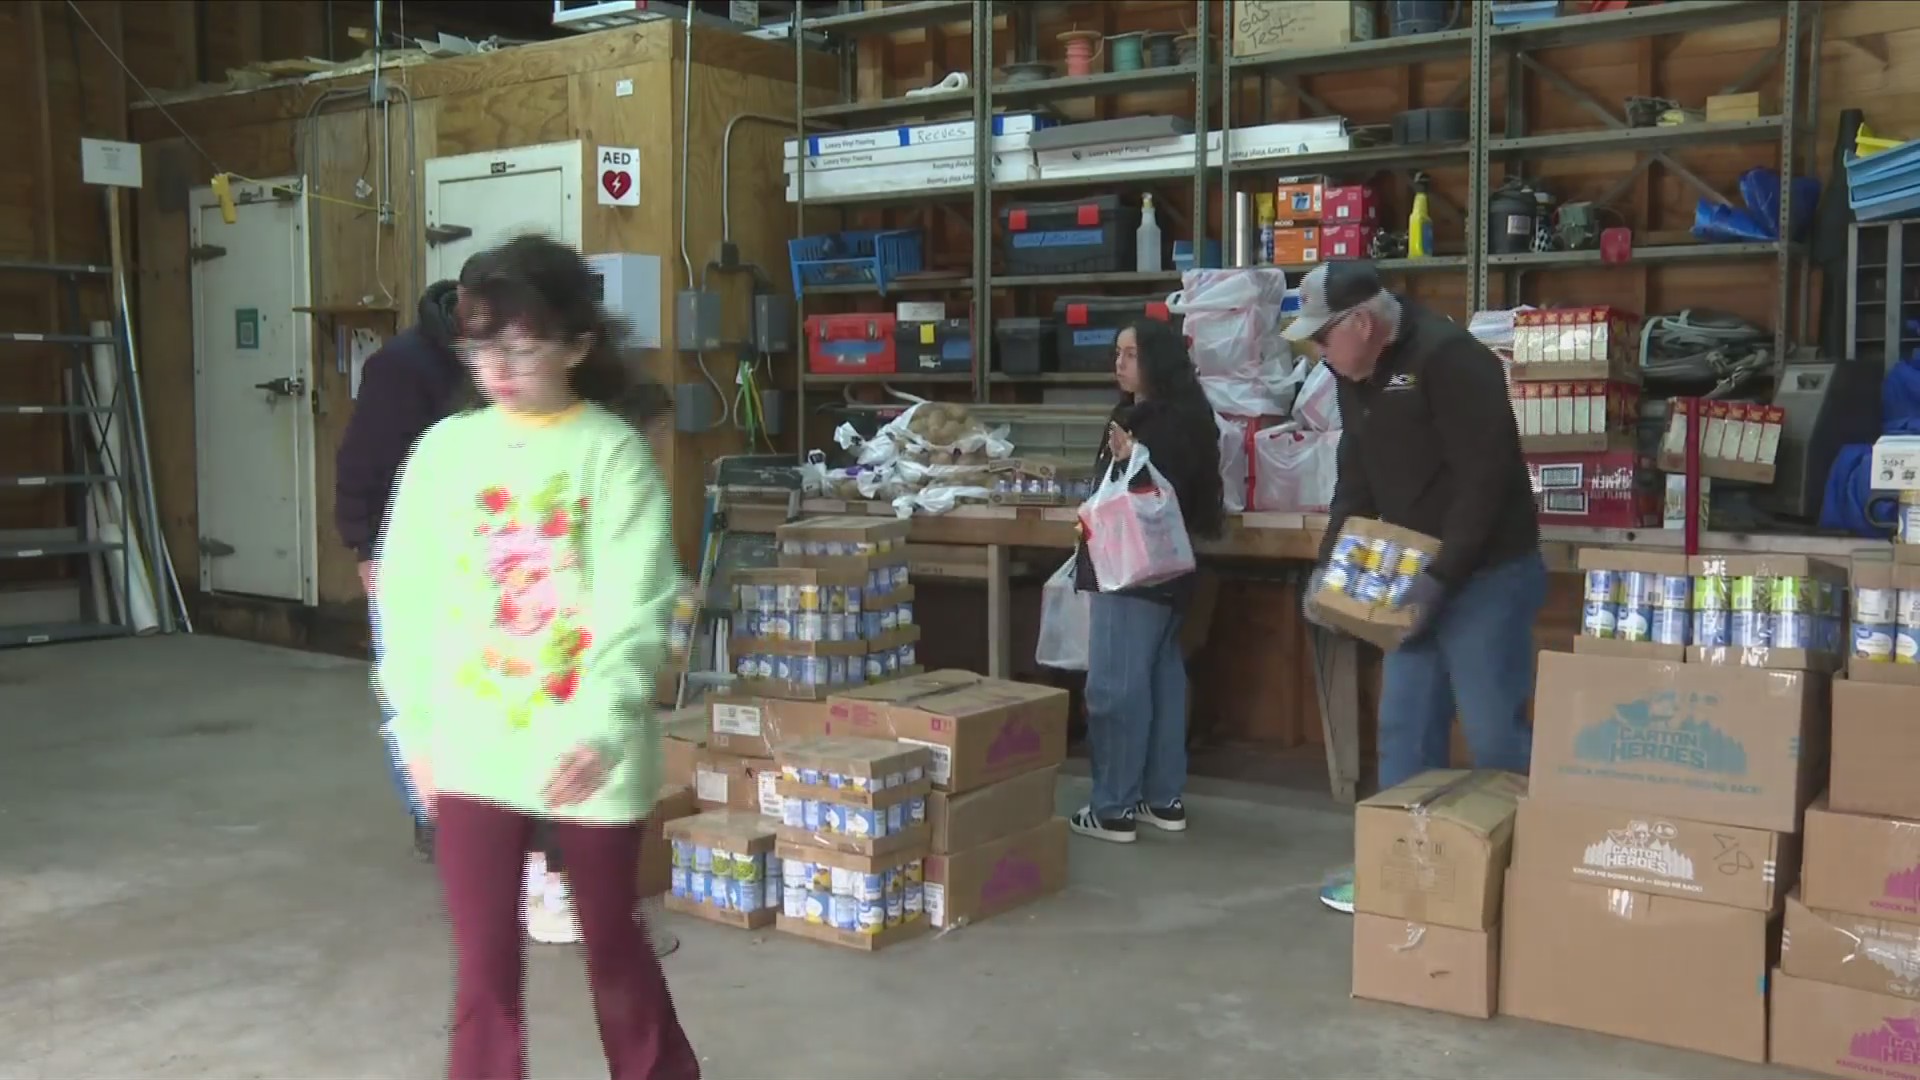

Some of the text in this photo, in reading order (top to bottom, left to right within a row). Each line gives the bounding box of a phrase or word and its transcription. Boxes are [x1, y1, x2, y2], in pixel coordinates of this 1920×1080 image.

[917, 127, 966, 144] Reeves
[602, 151, 631, 165] AED
[1621, 727, 1697, 746] CARTON
[1611, 742, 1705, 769] HEROES
[1612, 845, 1662, 860] CARTON
[1606, 855, 1667, 874] HEROES
